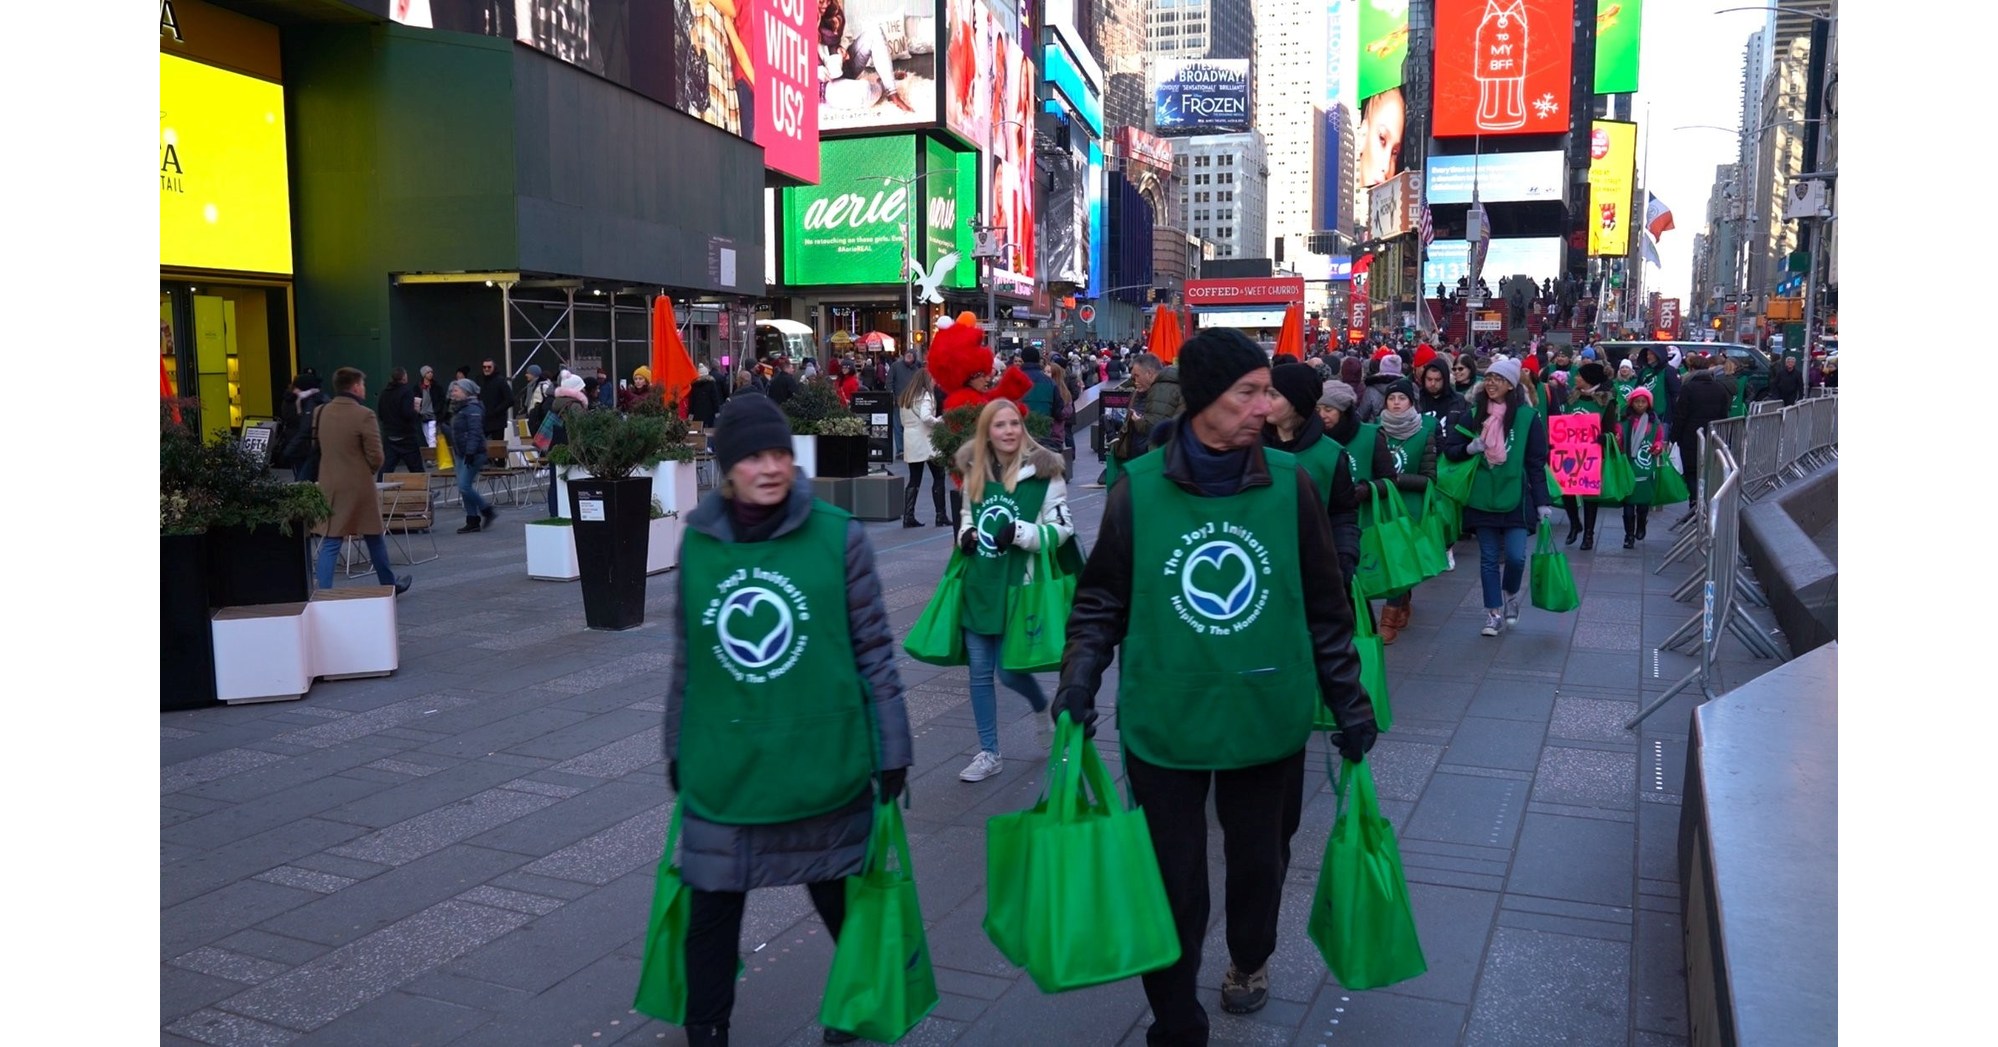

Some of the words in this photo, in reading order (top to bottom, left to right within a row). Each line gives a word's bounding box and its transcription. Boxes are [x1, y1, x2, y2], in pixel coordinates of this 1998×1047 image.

[764, 10, 808, 88] WITH
[1491, 44, 1513, 55] MY
[1180, 71, 1245, 82] BROADWAY!
[1490, 59, 1513, 70] BFF
[772, 77, 804, 140] US?
[1182, 94, 1244, 116] FROZEN
[160, 143, 183, 174] A
[804, 176, 906, 230] aerie
[1188, 287, 1239, 297] COFFEED
[1244, 286, 1266, 295] SWEET
[1268, 285, 1299, 295] CHURROS
[1353, 302, 1366, 328] tkts
[1660, 301, 1676, 328] tkts
[1550, 419, 1601, 444] SPREAD
[1164, 549, 1184, 576] The
[1181, 522, 1215, 545] JoyJ
[1222, 521, 1272, 575] Initiative
[1170, 595, 1206, 633] Helping
[1209, 625, 1231, 635] The
[1232, 588, 1270, 632] Homeless
